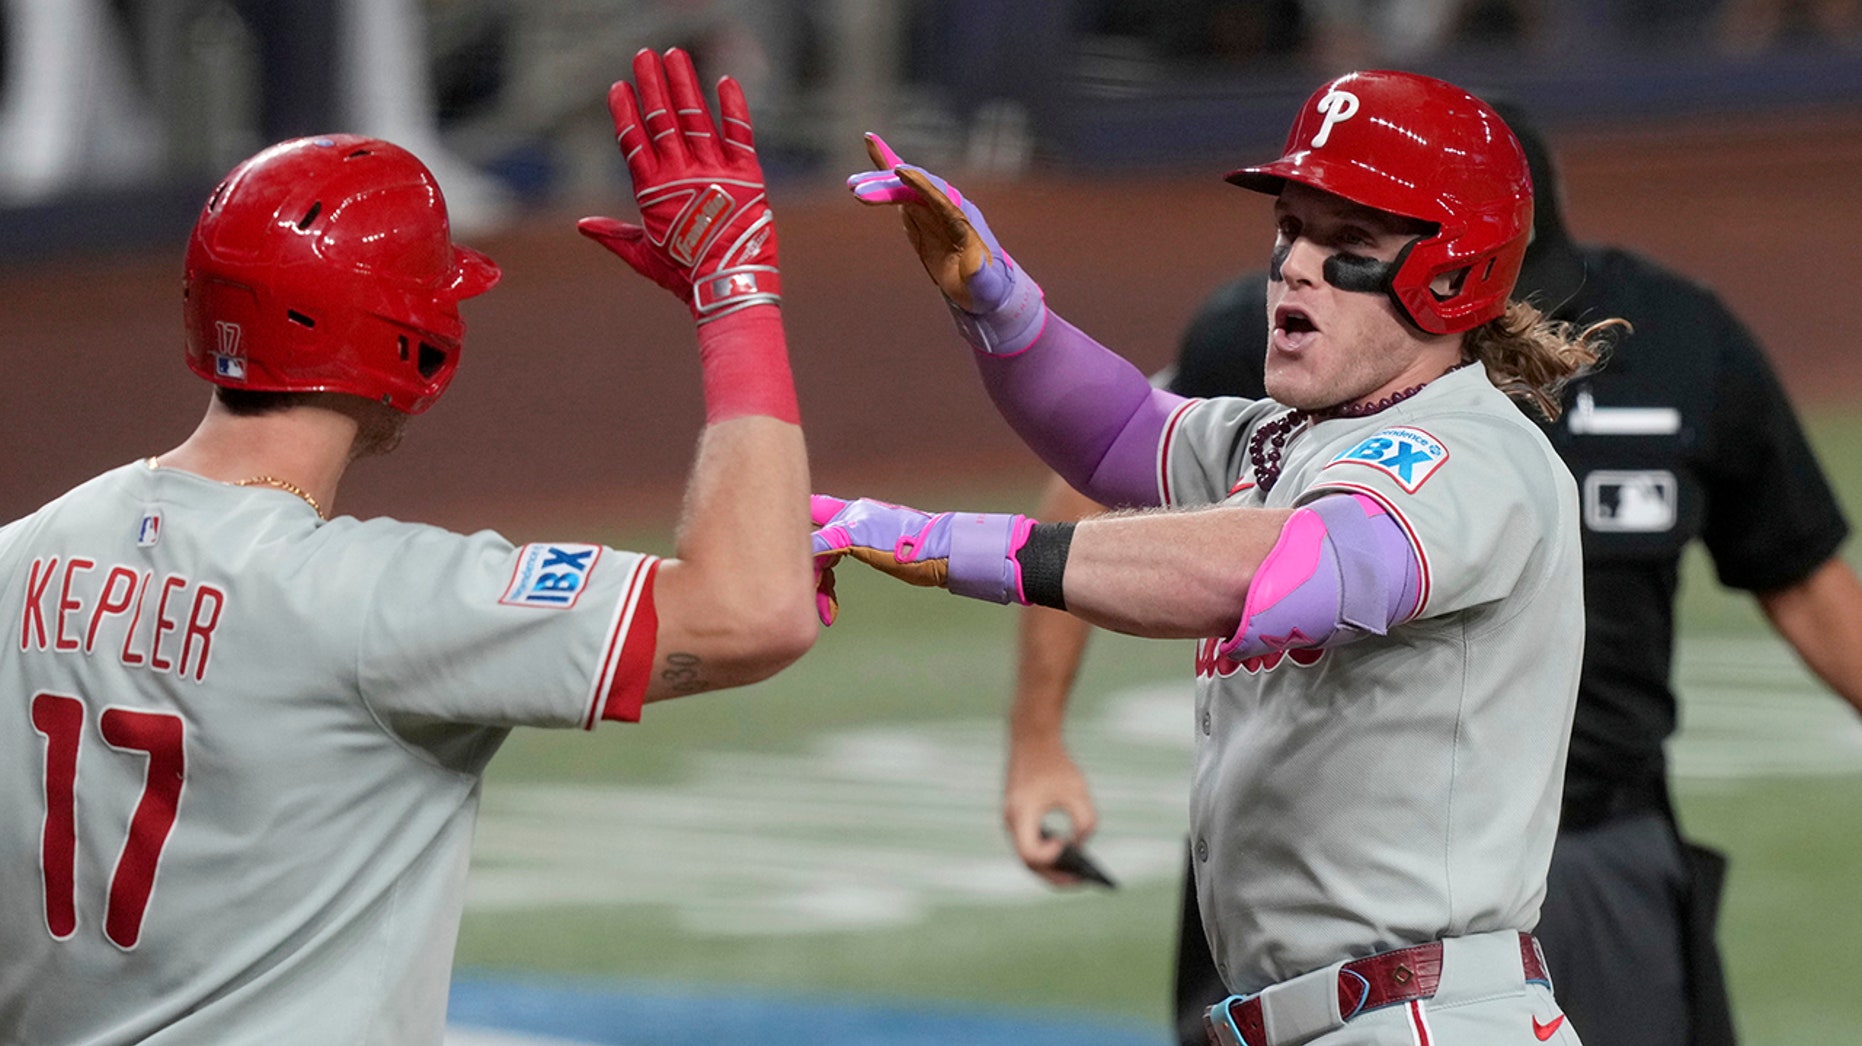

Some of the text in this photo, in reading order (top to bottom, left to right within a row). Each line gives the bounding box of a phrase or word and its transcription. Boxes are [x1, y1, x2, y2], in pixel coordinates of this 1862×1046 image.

[1311, 91, 1360, 149] P
[215, 320, 241, 356] 17
[525, 546, 593, 603] IBX
[20, 556, 226, 682] KEPLER
[31, 689, 187, 952] 17
